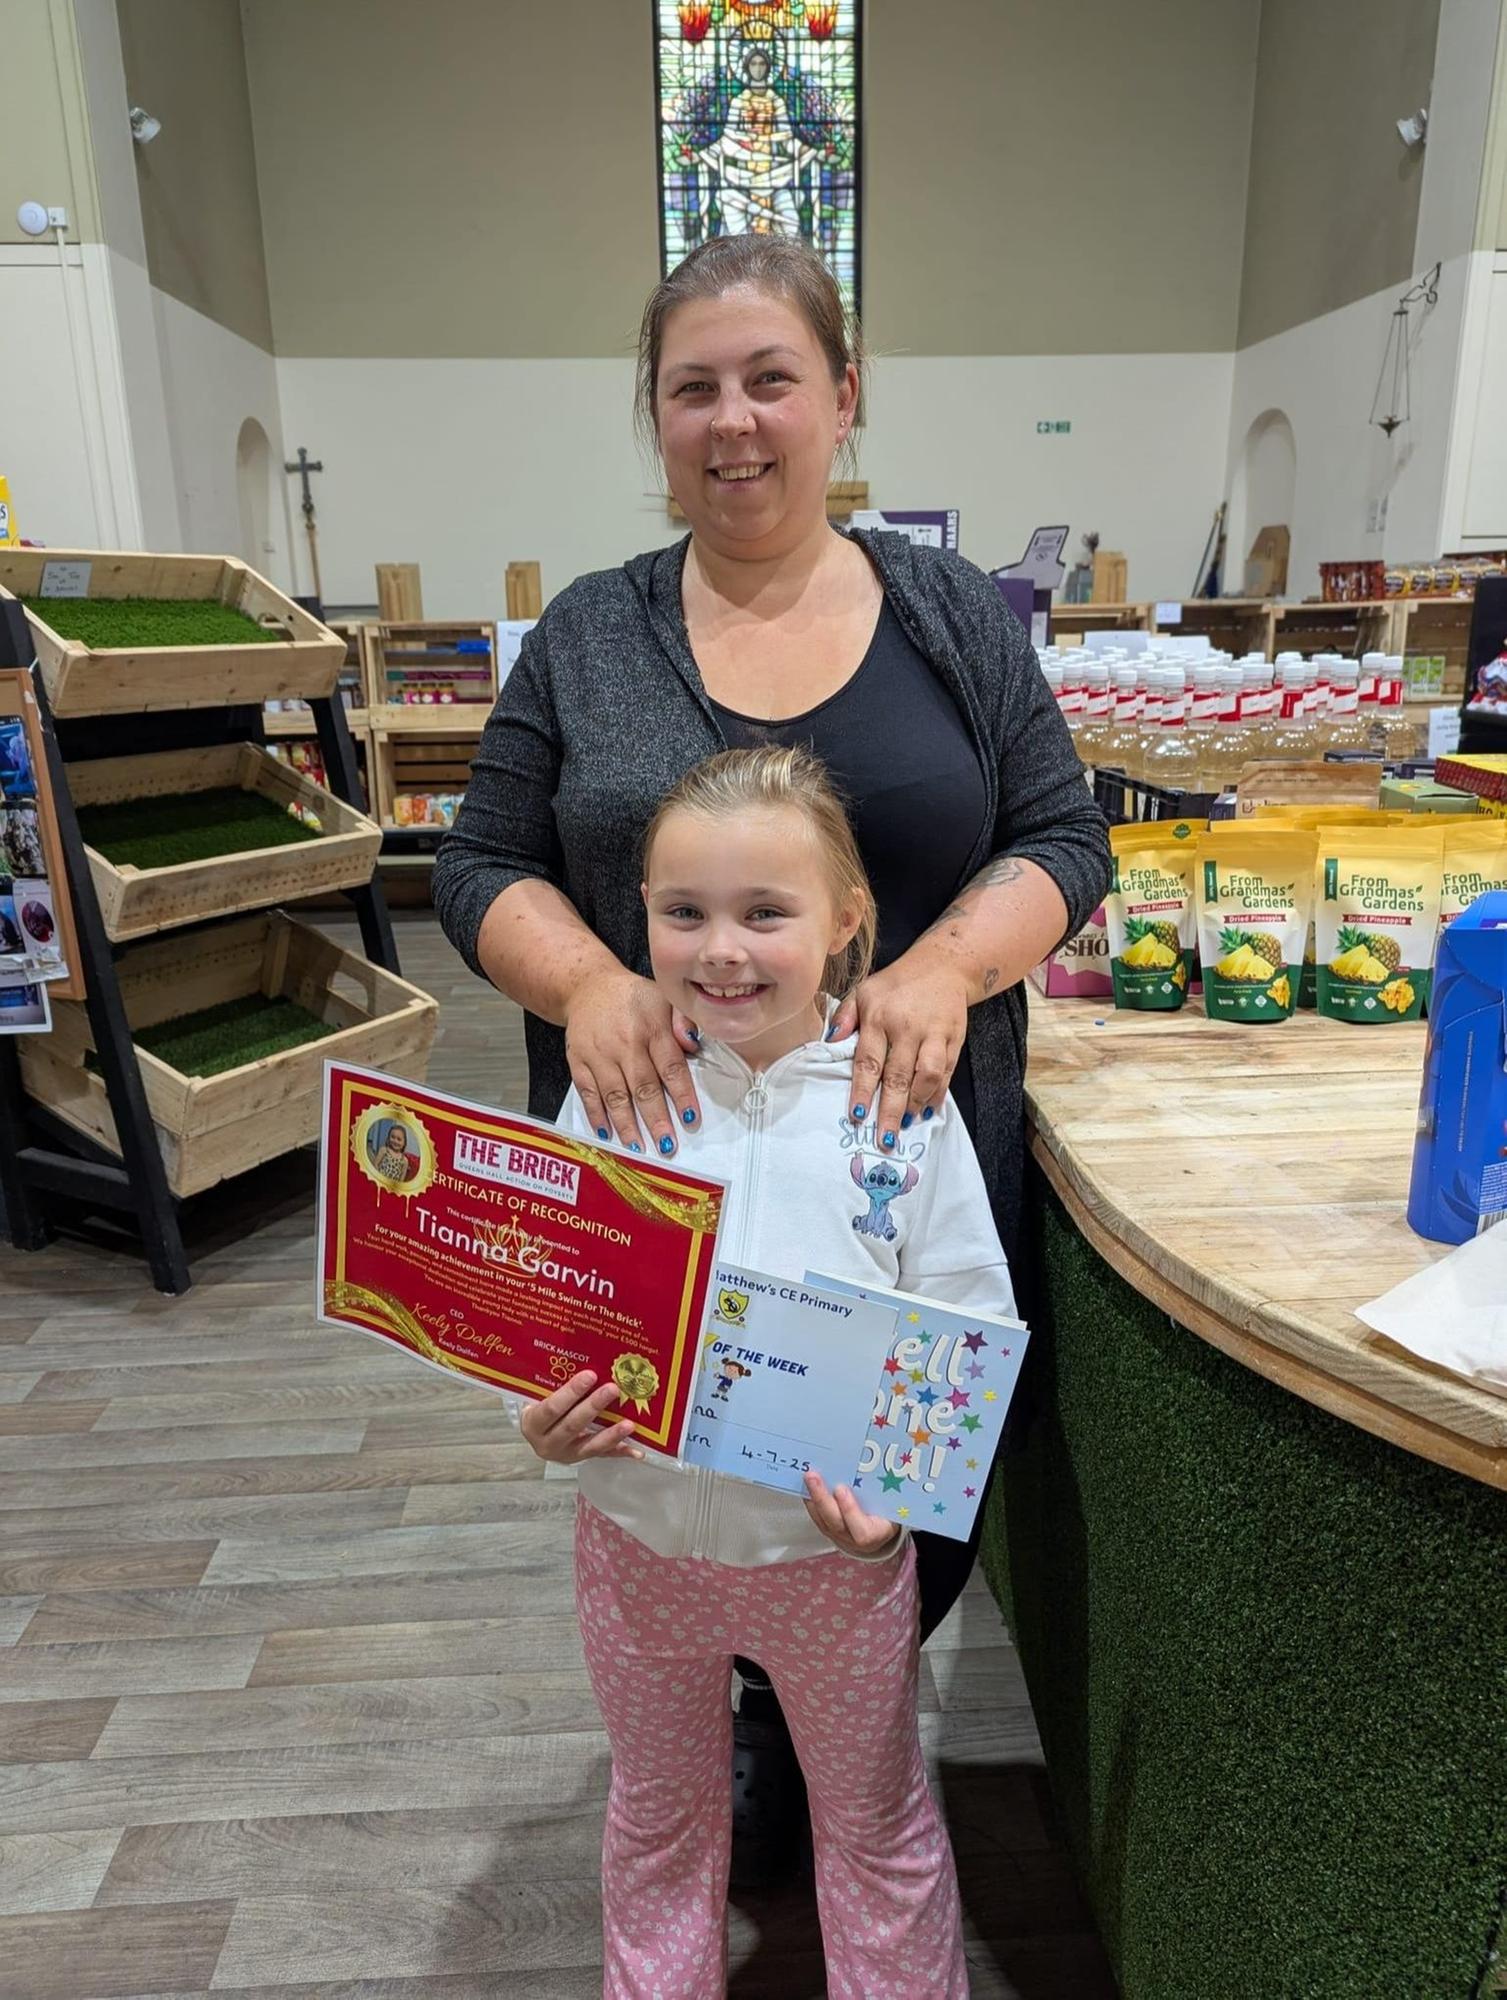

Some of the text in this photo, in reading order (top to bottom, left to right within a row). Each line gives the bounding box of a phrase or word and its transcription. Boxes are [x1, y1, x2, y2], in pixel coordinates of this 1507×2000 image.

[1129, 868, 1160, 880] From
[1230, 875, 1262, 886] From
[1351, 874, 1388, 887] From
[1443, 872, 1481, 885] From
[1122, 877, 1179, 891] Grandmas
[1220, 884, 1286, 898] Grandmas
[1340, 884, 1414, 899] Grandmas
[1441, 880, 1507, 896] randmas
[1144, 888, 1188, 901] Gardens
[1242, 896, 1294, 908] Gardens
[1362, 897, 1424, 911] Gardens
[1229, 915, 1249, 923] Dried
[1348, 915, 1406, 924] Dried Pineapple
[457, 1133, 576, 1191] THE BRICK
[486, 1170, 502, 1179] HALL
[505, 1175, 530, 1187] ACTION
[431, 1170, 631, 1247] ERTIFICATE OF RECOGNITION
[446, 1206, 458, 1216] This
[533, 1235, 570, 1254] presented
[571, 1247, 579, 1256] to
[414, 1206, 615, 1299] Tianna Garvin
[374, 1223, 388, 1235] For
[389, 1230, 407, 1243] your
[407, 1237, 439, 1259] amazing
[440, 1252, 494, 1278] achievement
[495, 1271, 504, 1281] in
[505, 1276, 525, 1290] your
[537, 1284, 556, 1298] Mile
[558, 1291, 582, 1307] Swim
[583, 1299, 597, 1312] for
[598, 1305, 614, 1318] The
[716, 1270, 853, 1317] atthew's CE Primary
[449, 1308, 464, 1319] CEO
[453, 1287, 480, 1301] incredible
[482, 1298, 500, 1310] young
[501, 1304, 514, 1314] lady
[516, 1309, 528, 1318] with
[535, 1315, 552, 1326] heart
[456, 1280, 467, 1288] and
[468, 1284, 496, 1298] celebrate
[497, 1294, 510, 1304] your
[512, 1298, 538, 1312] fantastic
[605, 1331, 619, 1341] your
[620, 1335, 638, 1346] £500
[495, 1284, 512, 1294] made
[519, 1292, 540, 1305] lasting
[542, 1300, 563, 1312] impact
[573, 1310, 588, 1319] each
[590, 1316, 602, 1324] and
[603, 1322, 619, 1332] every
[410, 1303, 516, 1356] Keely Dalfen
[533, 1338, 589, 1364] BRICK MASCOT
[712, 1341, 809, 1376] OF THE WEEK
[889, 1334, 967, 1387] ell
